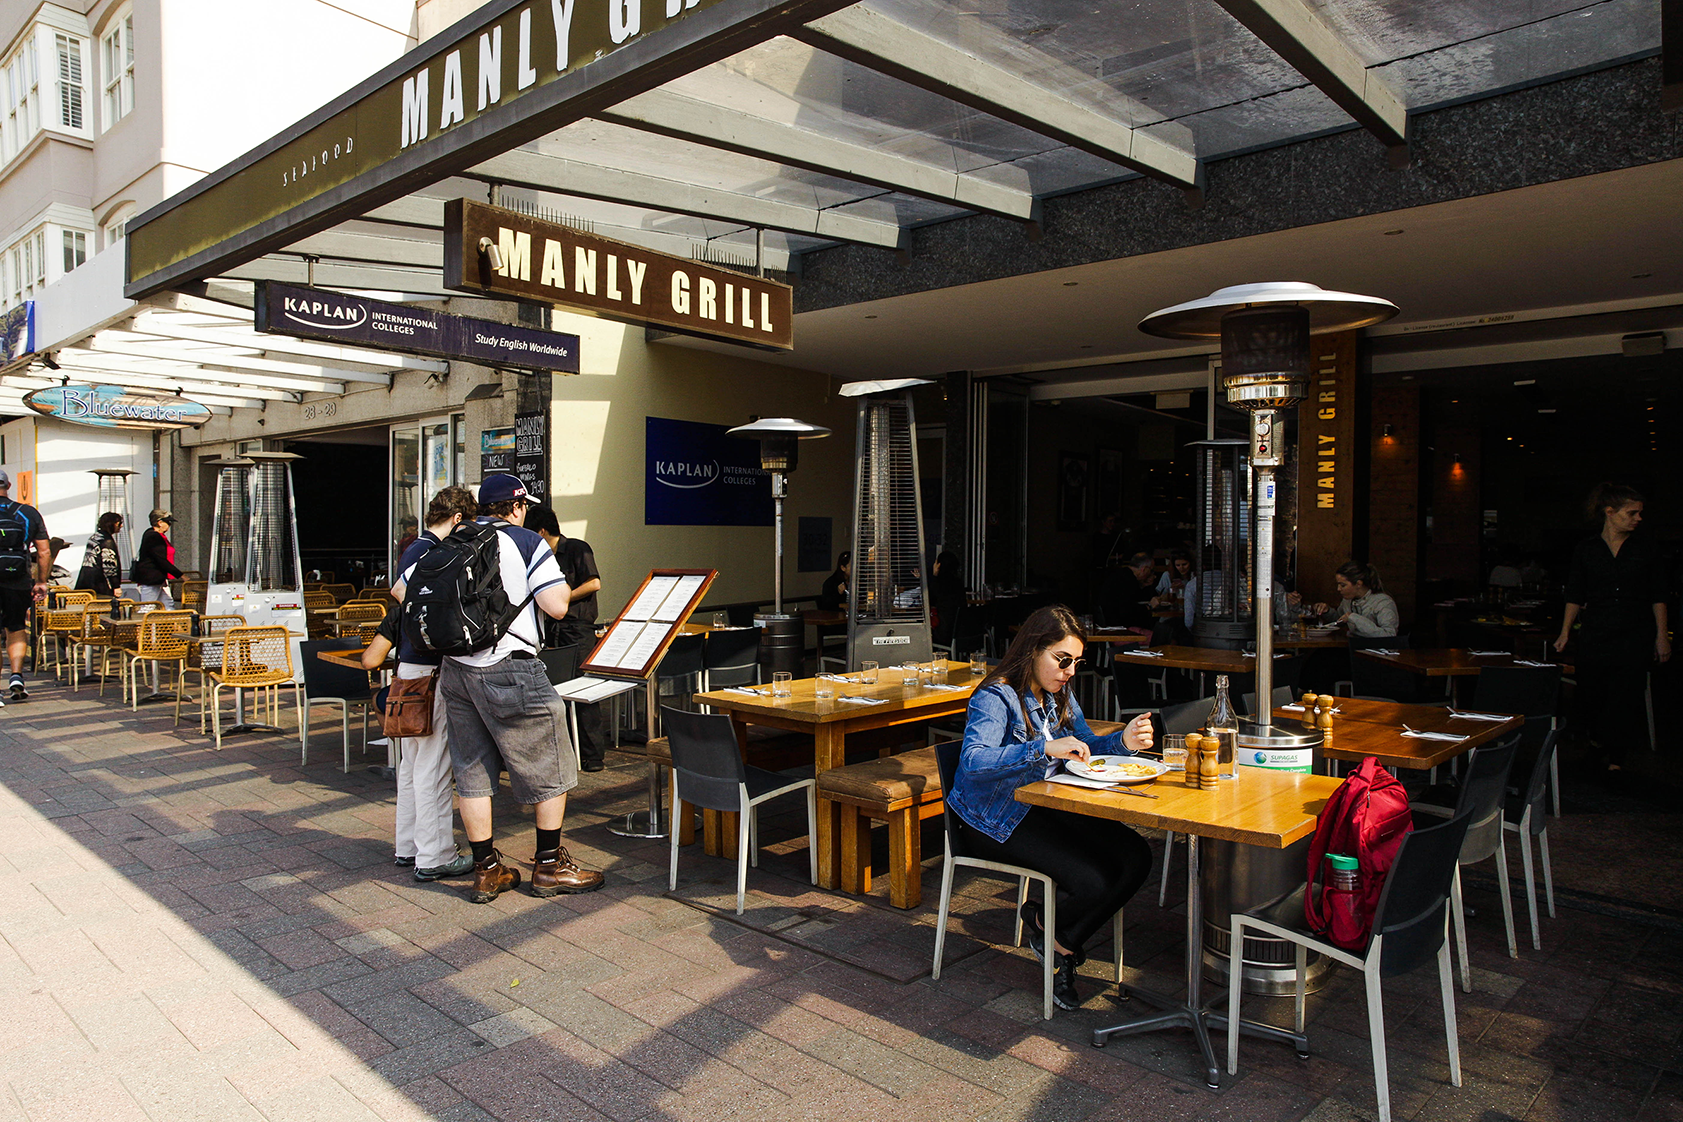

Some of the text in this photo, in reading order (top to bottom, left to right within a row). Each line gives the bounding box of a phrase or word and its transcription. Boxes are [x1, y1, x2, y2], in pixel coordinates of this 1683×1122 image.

[401, 0, 574, 149] MANLY
[283, 136, 354, 187] SEAFOOD
[498, 227, 773, 332] MANLY GRILL
[284, 297, 358, 322] KAPLAN
[371, 321, 415, 336] COLLEGES
[372, 312, 438, 330] INTERNATIONAL
[475, 333, 568, 357] Study English Worldwide
[60, 389, 187, 422] Bluewater
[515, 415, 544, 436] MANLY
[1317, 352, 1336, 508] MANLY GRILL
[516, 435, 542, 452] GRILL
[488, 454, 504, 468] NEW
[655, 460, 713, 477] KAPLAN
[723, 476, 756, 485] COLLEGES
